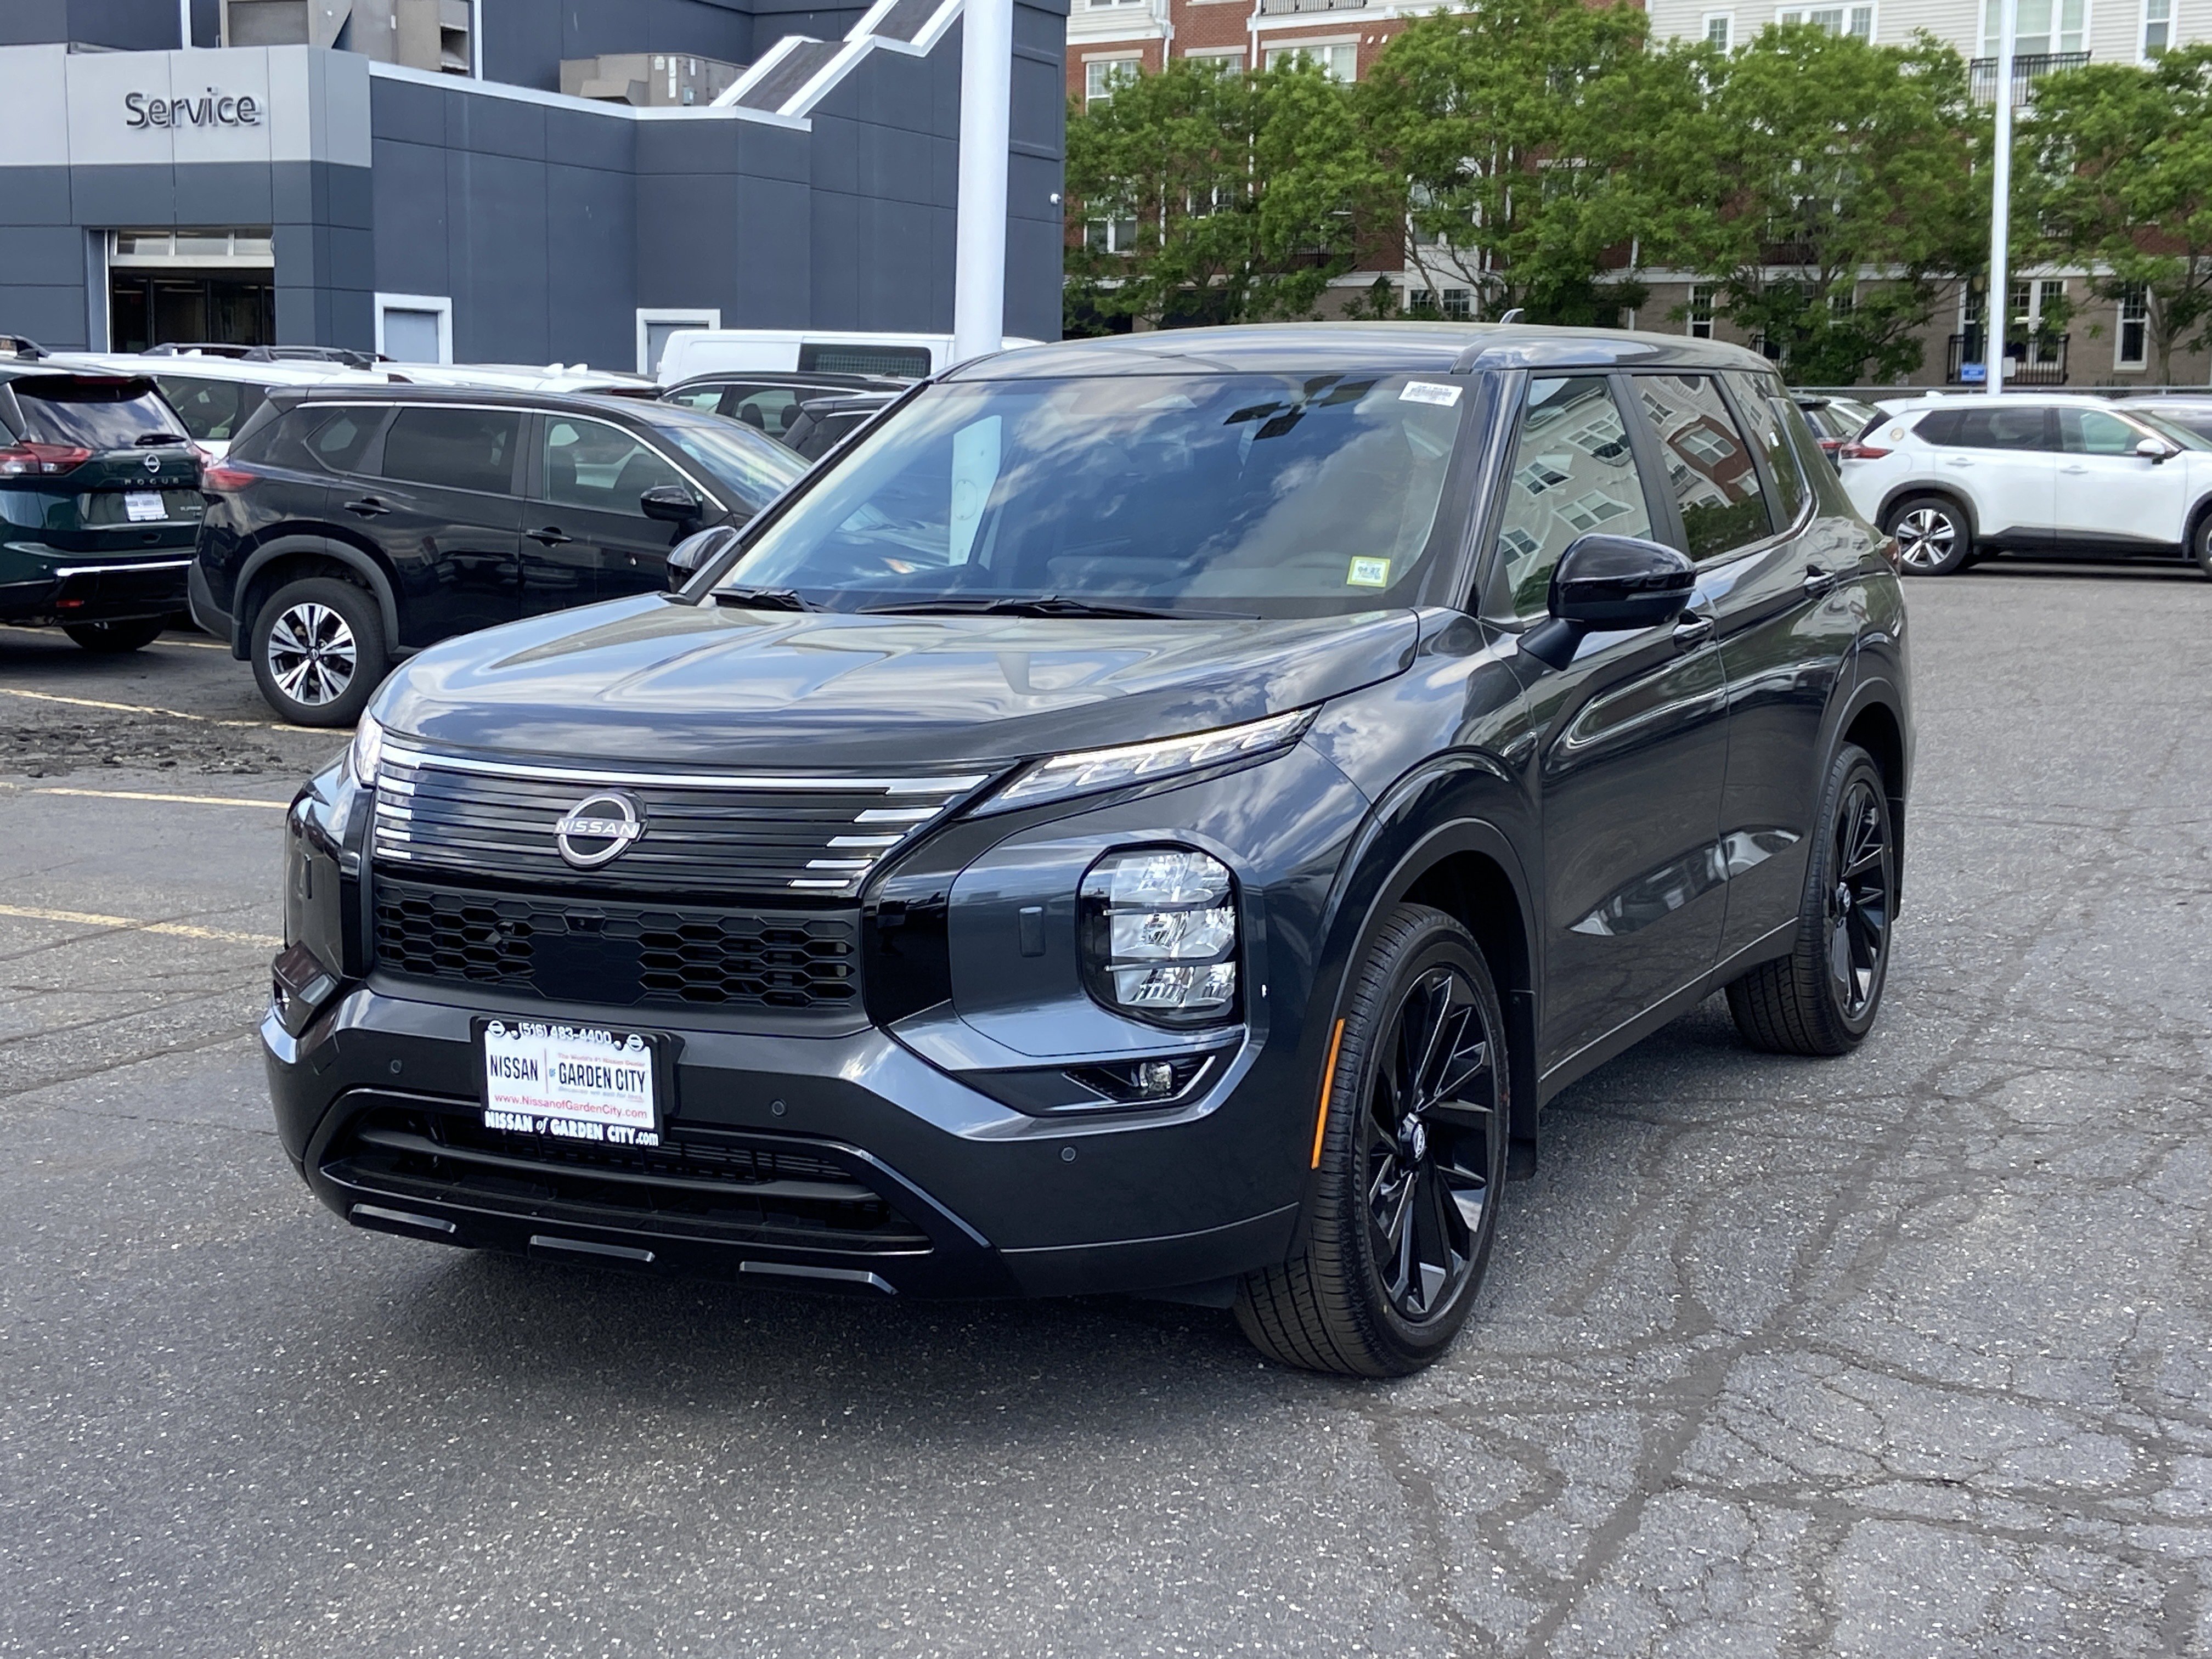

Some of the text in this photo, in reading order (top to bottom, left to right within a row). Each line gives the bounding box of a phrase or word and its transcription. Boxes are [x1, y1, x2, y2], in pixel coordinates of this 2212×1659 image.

[125, 87, 257, 127] Service
[556, 820, 637, 839] NISSAN
[550, 1025, 612, 1045] 483-4400
[490, 1054, 538, 1082] NISSAN
[558, 1062, 612, 1090] GARDEN
[616, 1068, 646, 1093] CITY
[494, 1094, 648, 1119] www.NissanofGardenCity.com
[484, 1110, 659, 1147] NISSAN of GARDEN CITY.com
